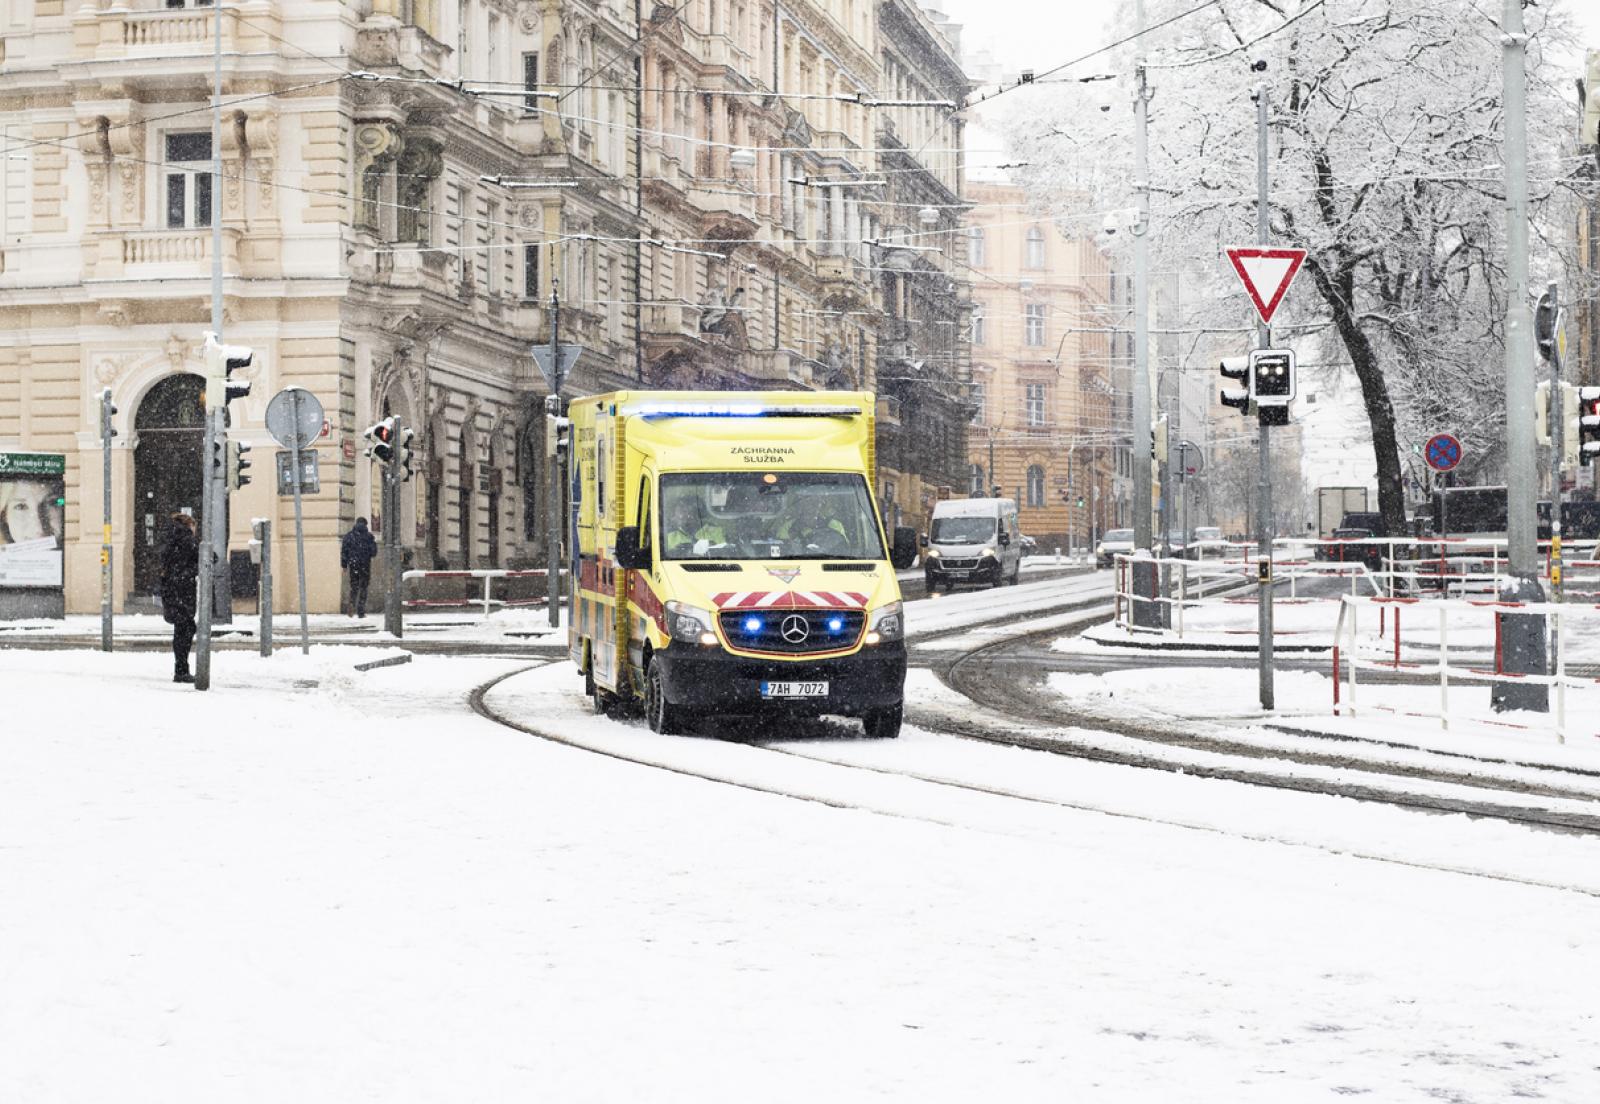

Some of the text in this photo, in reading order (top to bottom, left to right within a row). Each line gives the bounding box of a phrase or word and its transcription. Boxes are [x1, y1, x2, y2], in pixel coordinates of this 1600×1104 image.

[730, 446, 795, 454] ZÁCHRANNÁ
[743, 454, 785, 462] SLUŽBA
[770, 683, 790, 695] 7AH
[798, 683, 825, 695] 7072
